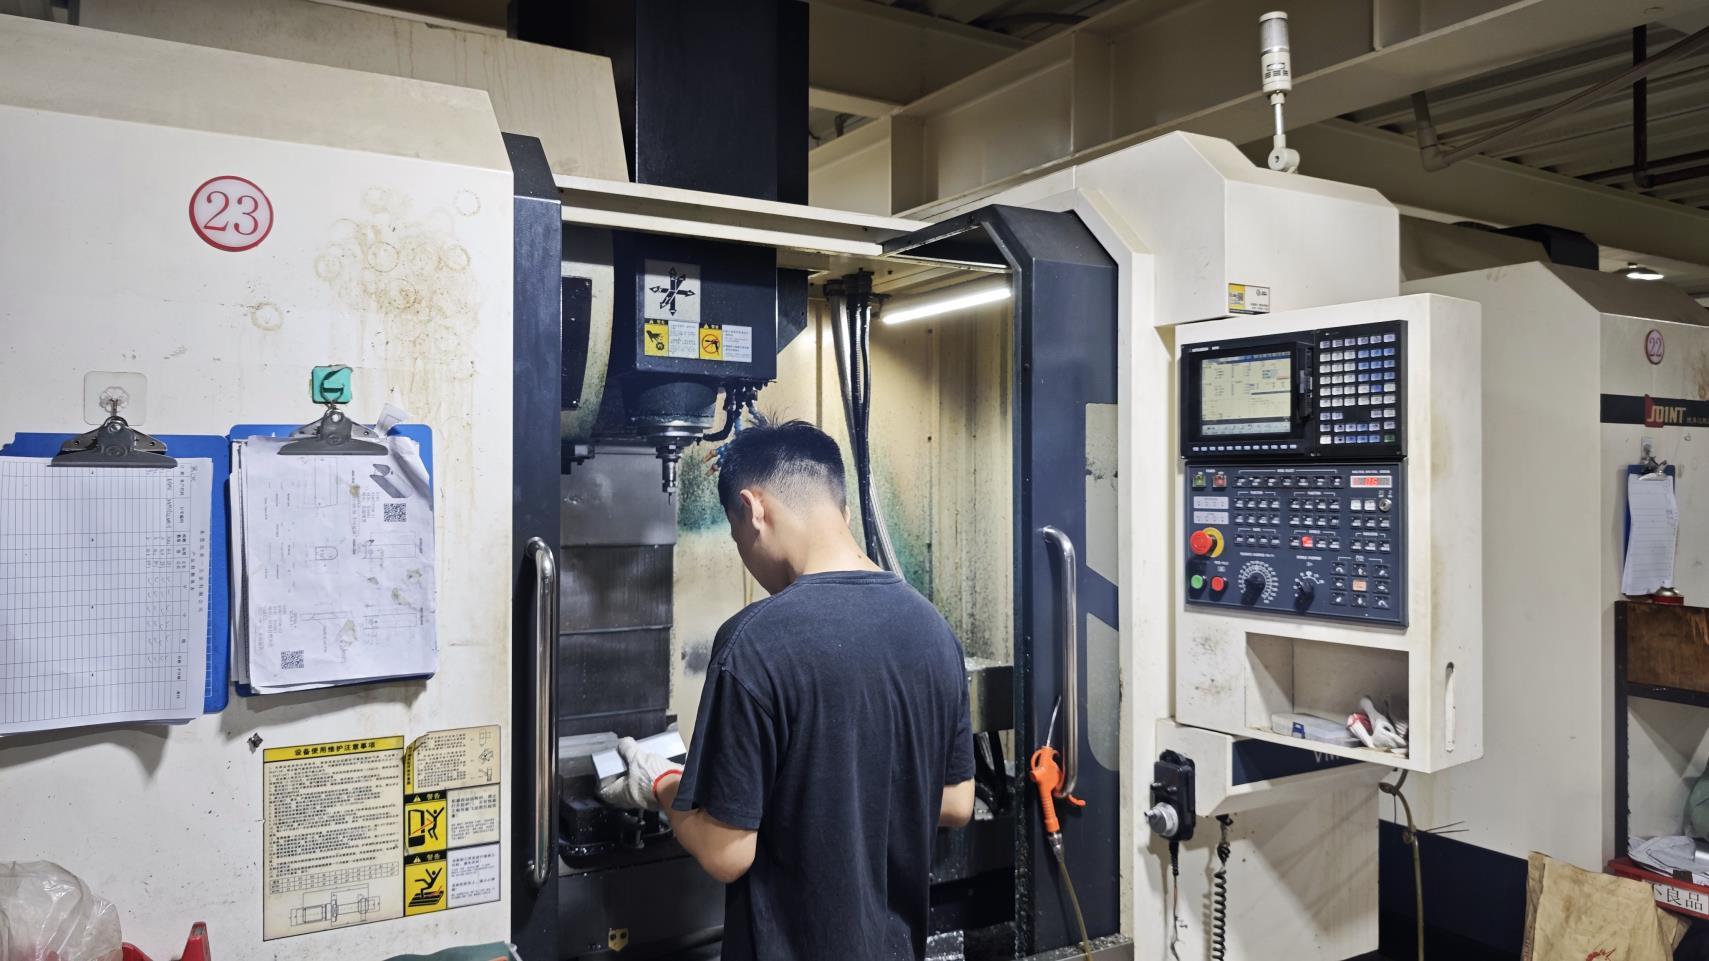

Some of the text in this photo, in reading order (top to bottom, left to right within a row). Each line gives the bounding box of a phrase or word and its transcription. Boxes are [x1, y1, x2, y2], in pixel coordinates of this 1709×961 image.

[203, 190, 259, 236] 23
[1648, 336, 1662, 357] 22
[1646, 405, 1686, 424] JOINT
[294, 742, 375, 756] 设备使用维护注意事项
